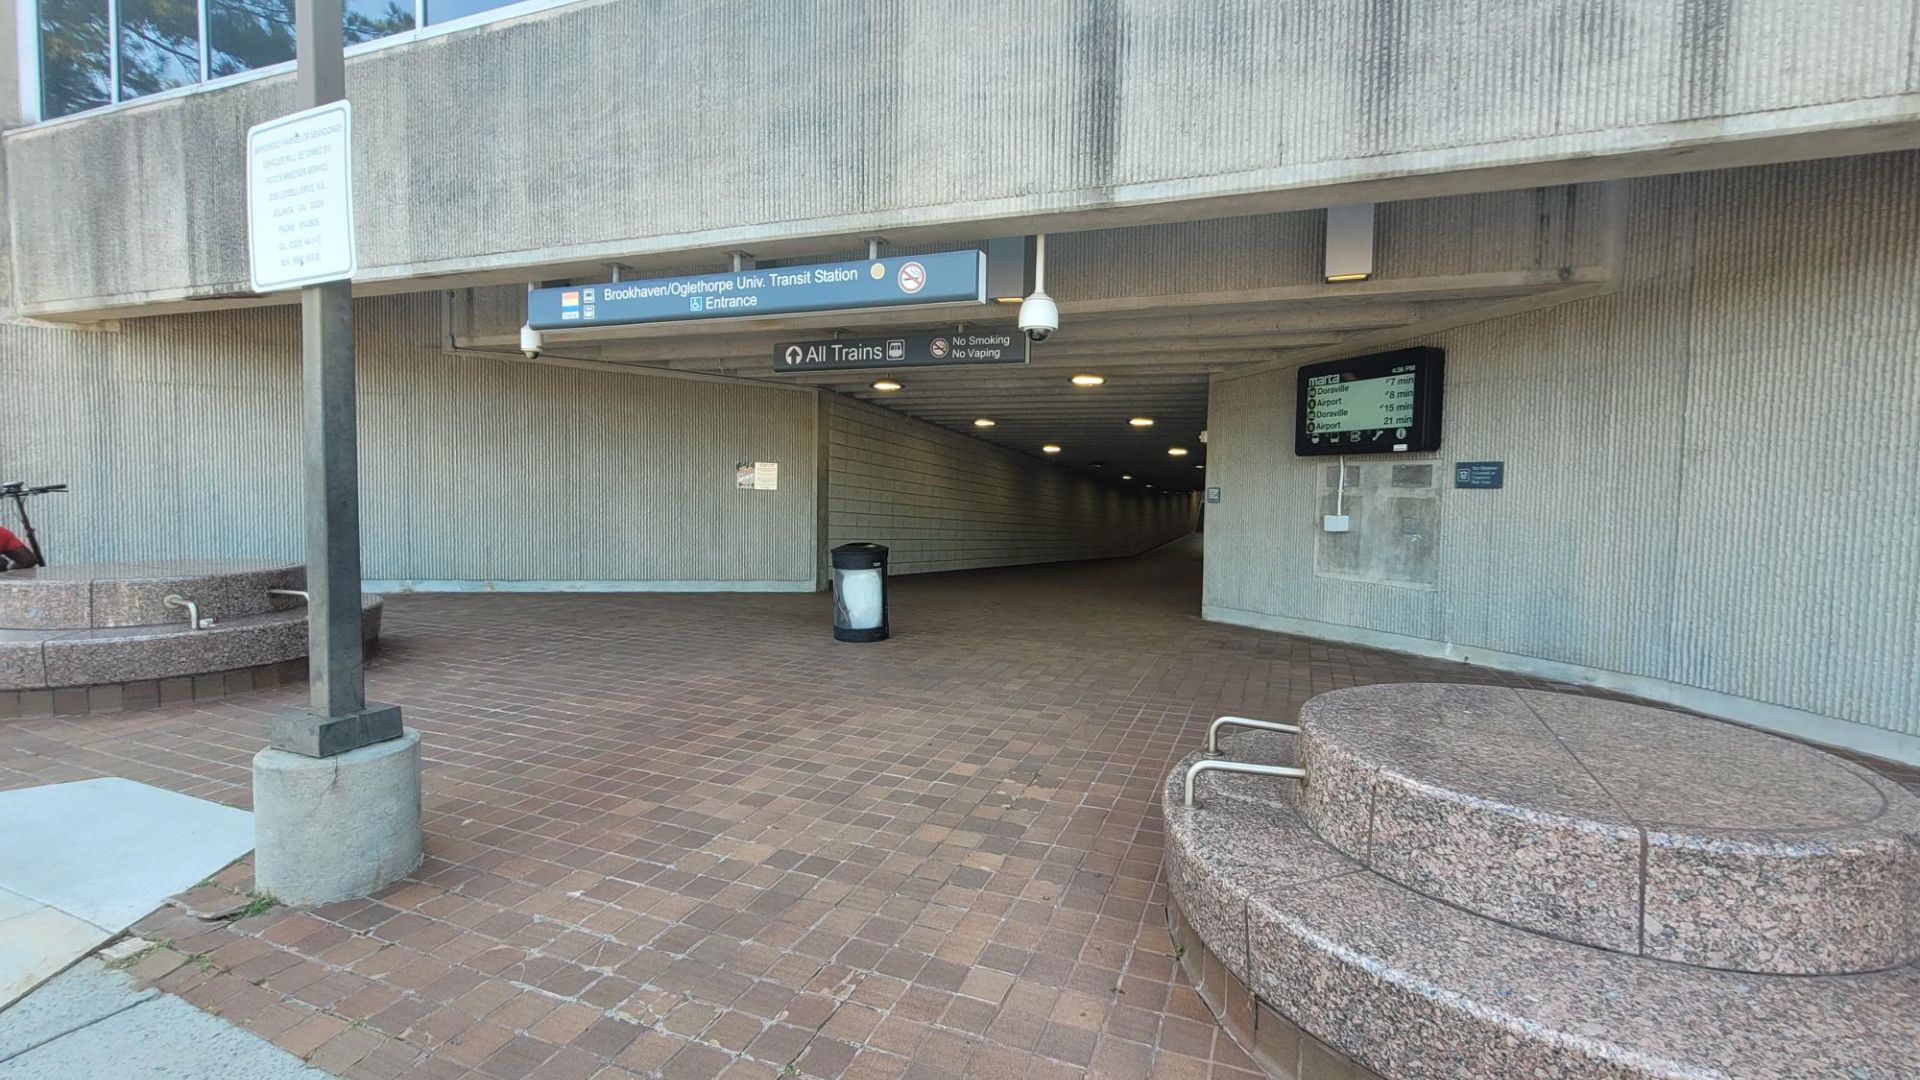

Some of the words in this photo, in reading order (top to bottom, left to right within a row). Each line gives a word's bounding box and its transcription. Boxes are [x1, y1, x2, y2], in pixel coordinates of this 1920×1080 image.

[604, 281, 733, 301] Brookhaven/Oglethorpe
[736, 276, 766, 290] Univ.
[769, 271, 811, 288] Transit
[814, 268, 858, 284] Station
[705, 295, 758, 310] Entrance
[952, 336, 966, 346] No
[969, 335, 1010, 347] Smoking
[806, 345, 826, 362] All
[831, 344, 883, 362] Trains
[952, 349, 966, 359] No
[968, 348, 1000, 360] Vaping
[1309, 374, 1340, 387] marta
[1317, 384, 1350, 395] Doraville
[1397, 376, 1414, 385] min
[1316, 397, 1342, 408] Airport
[1389, 390, 1395, 399] 8
[1397, 388, 1413, 398] min
[1316, 409, 1349, 419] Doraville
[1384, 404, 1395, 412] 15
[1396, 402, 1413, 411] min
[1316, 421, 1341, 431] Airport
[1383, 417, 1393, 425] 21
[1395, 415, 1412, 424] min
